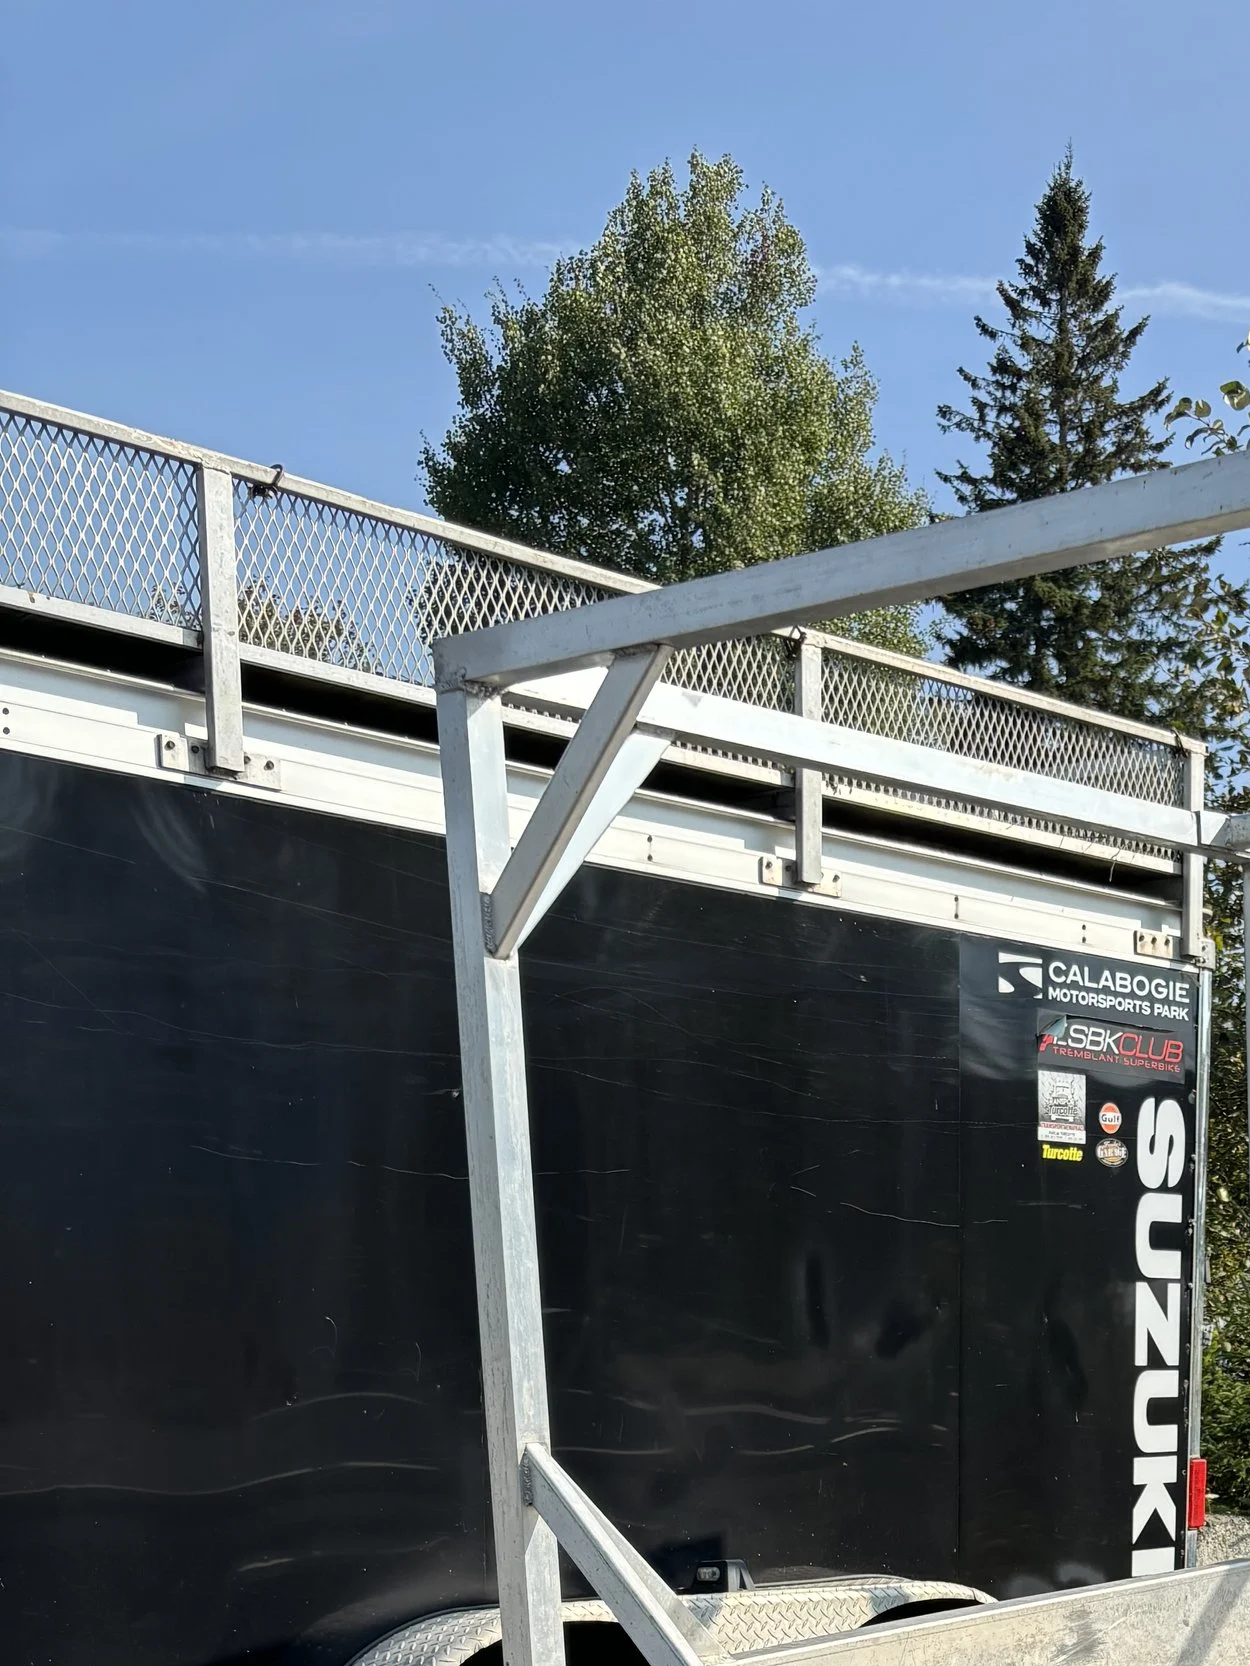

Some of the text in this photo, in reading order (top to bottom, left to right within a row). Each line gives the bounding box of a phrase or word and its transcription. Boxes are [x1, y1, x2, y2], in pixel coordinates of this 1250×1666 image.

[1049, 962, 1190, 1003] CALABOGIE
[1048, 987, 1189, 1021] MOTORSPORTS PARK
[1053, 1046, 1181, 1073] TREMBLANT SUPERBIKE
[1101, 1114, 1120, 1123] Gulf
[1042, 1144, 1084, 1162] Turcotte
[1131, 1097, 1187, 1577] SUZUKI
